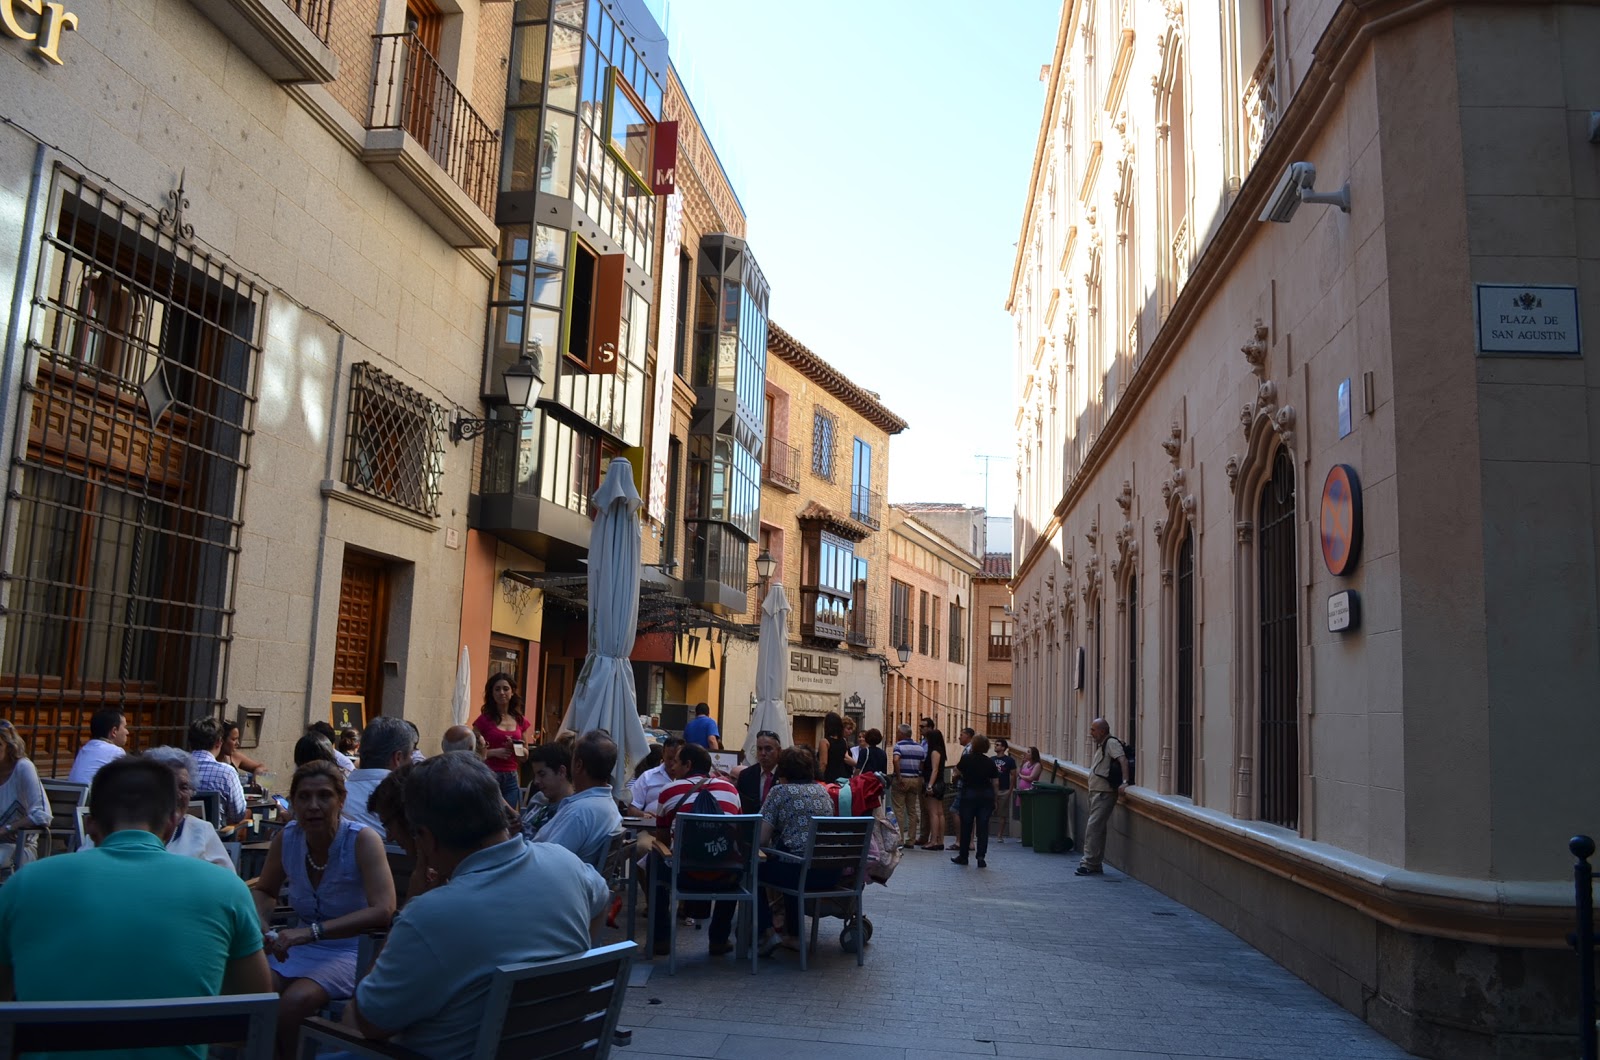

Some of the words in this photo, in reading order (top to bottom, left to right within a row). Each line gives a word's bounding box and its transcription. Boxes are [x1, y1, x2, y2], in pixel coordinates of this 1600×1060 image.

[656, 167, 674, 186] M
[1500, 315, 1536, 325] PLAZA
[1544, 316, 1559, 326] DE
[1491, 330, 1514, 339] SAN
[598, 342, 615, 363] S
[790, 651, 839, 677] SOLISS
